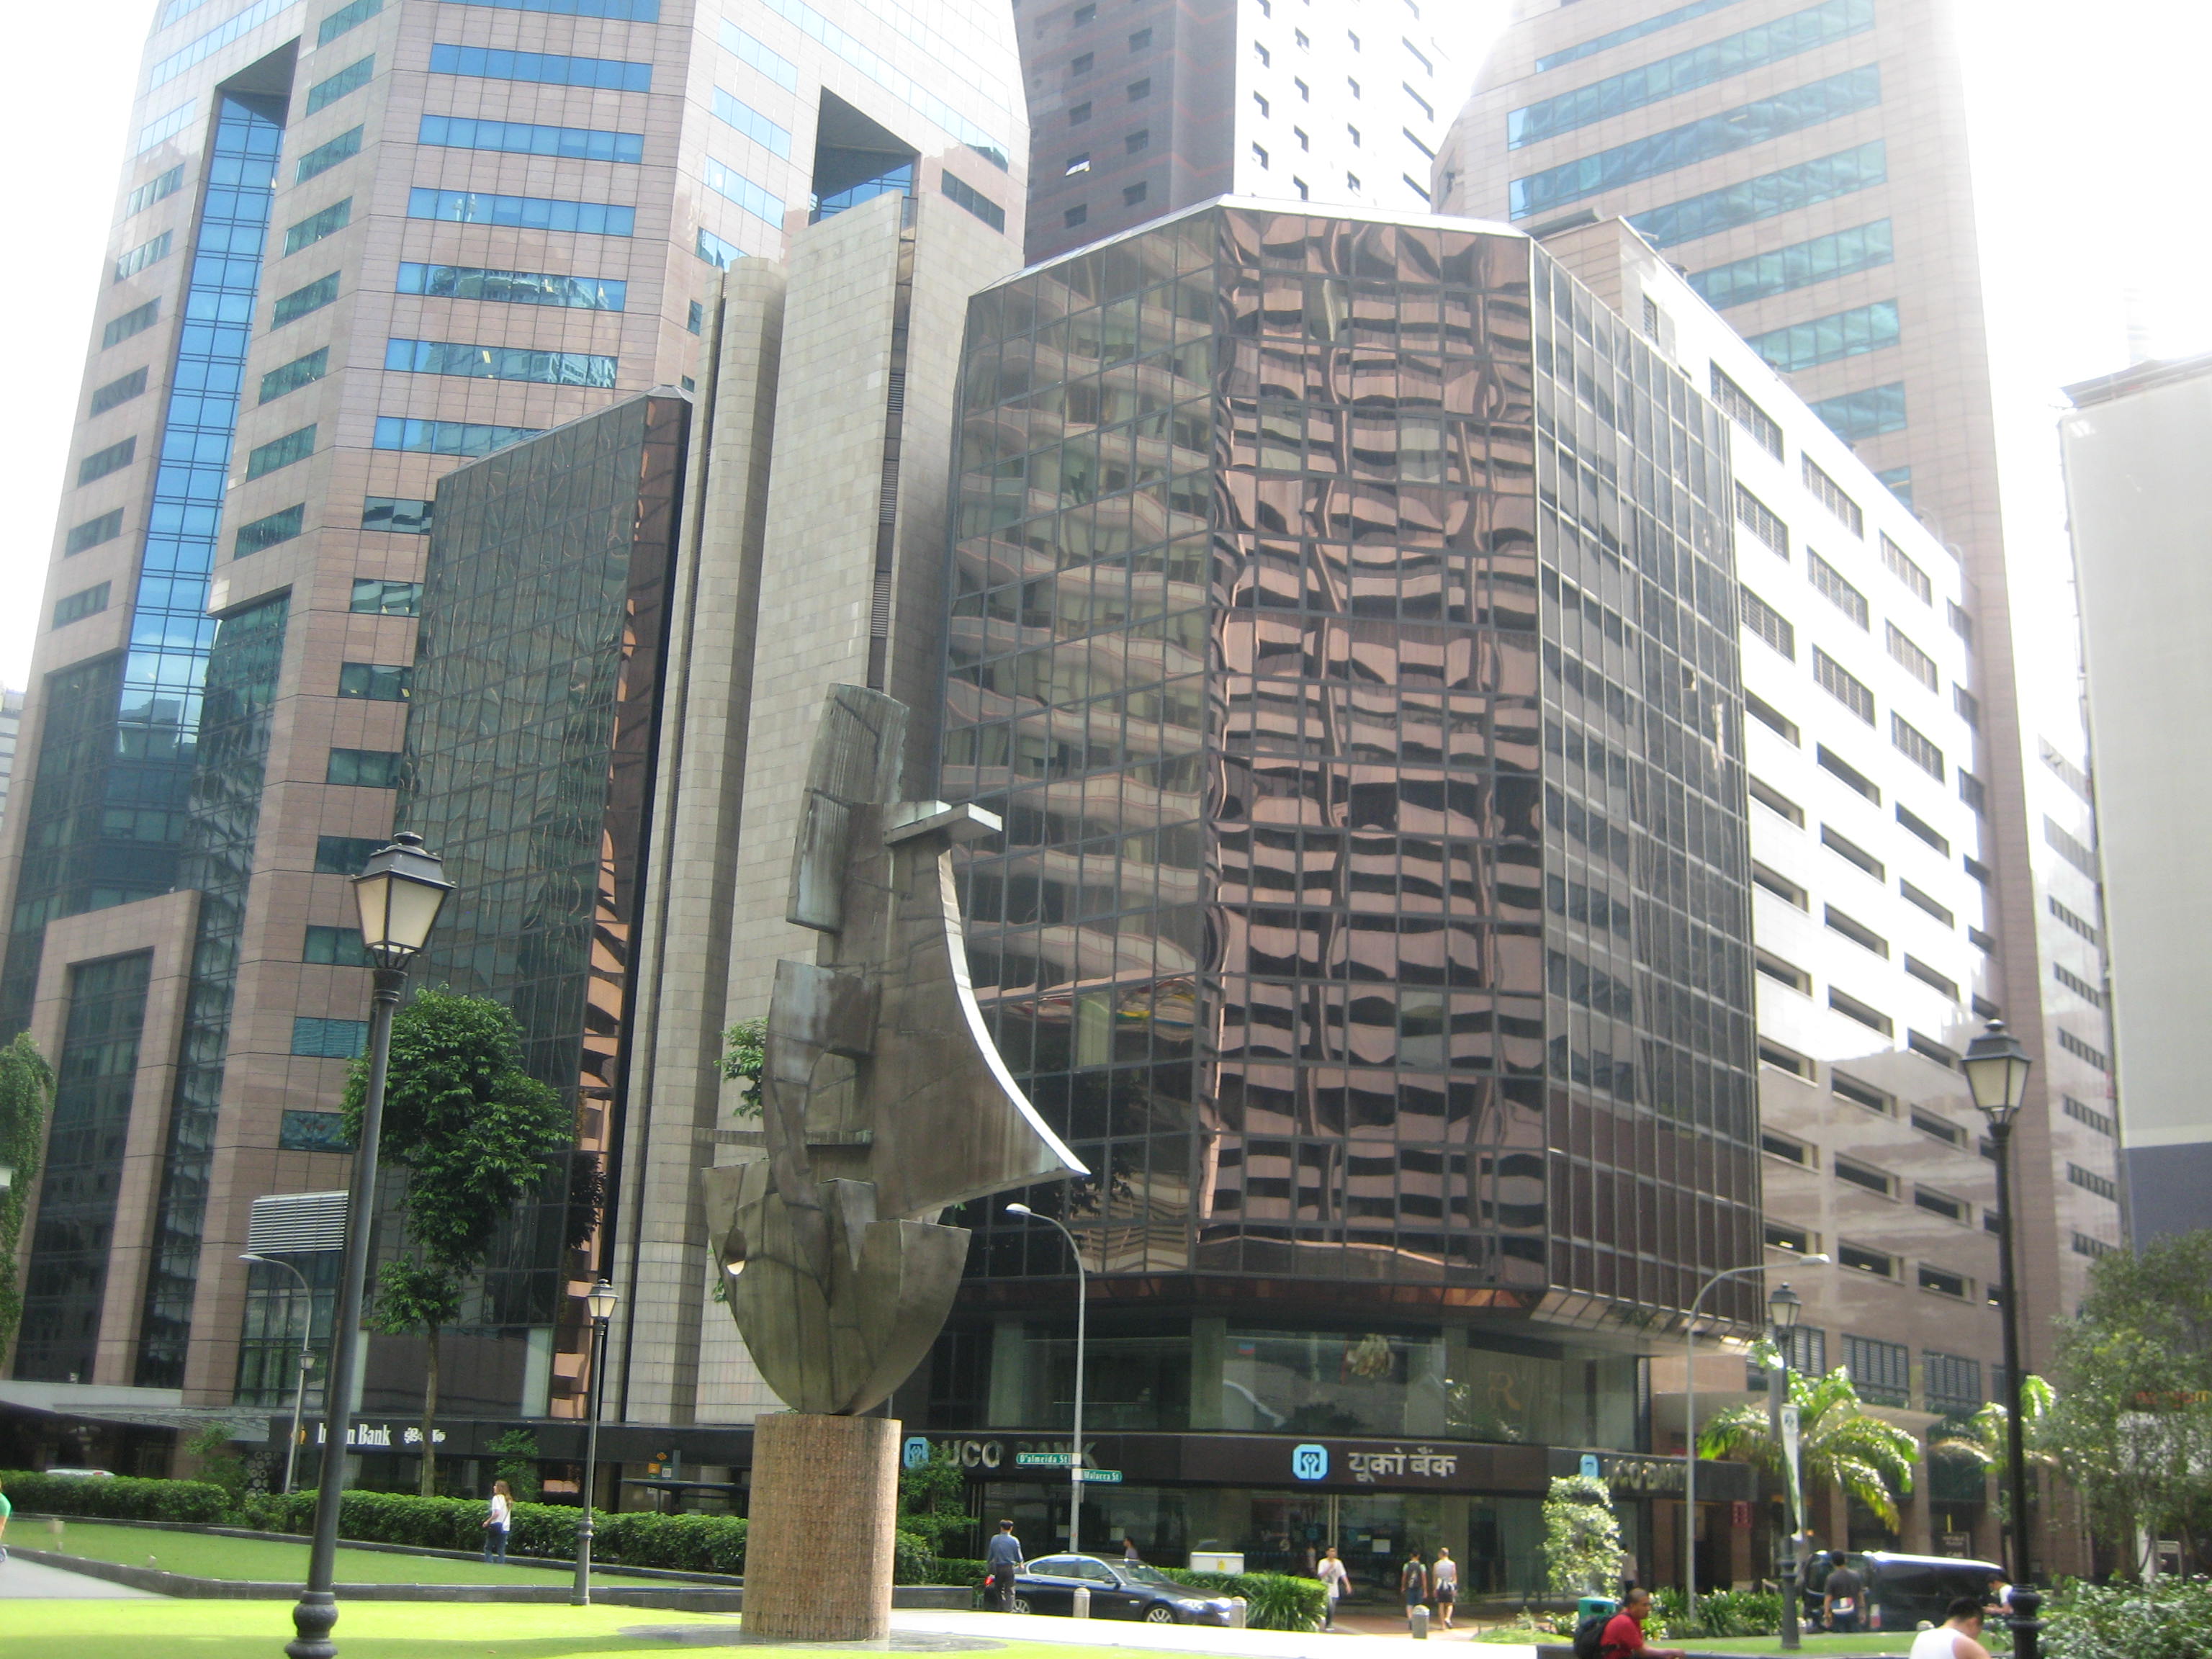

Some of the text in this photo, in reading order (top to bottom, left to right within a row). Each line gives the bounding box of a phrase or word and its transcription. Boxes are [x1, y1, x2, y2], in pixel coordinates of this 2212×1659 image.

[358, 1424, 392, 1445] Bank
[941, 1439, 1002, 1468] UCO
[1348, 1446, 1406, 1483] यूको
